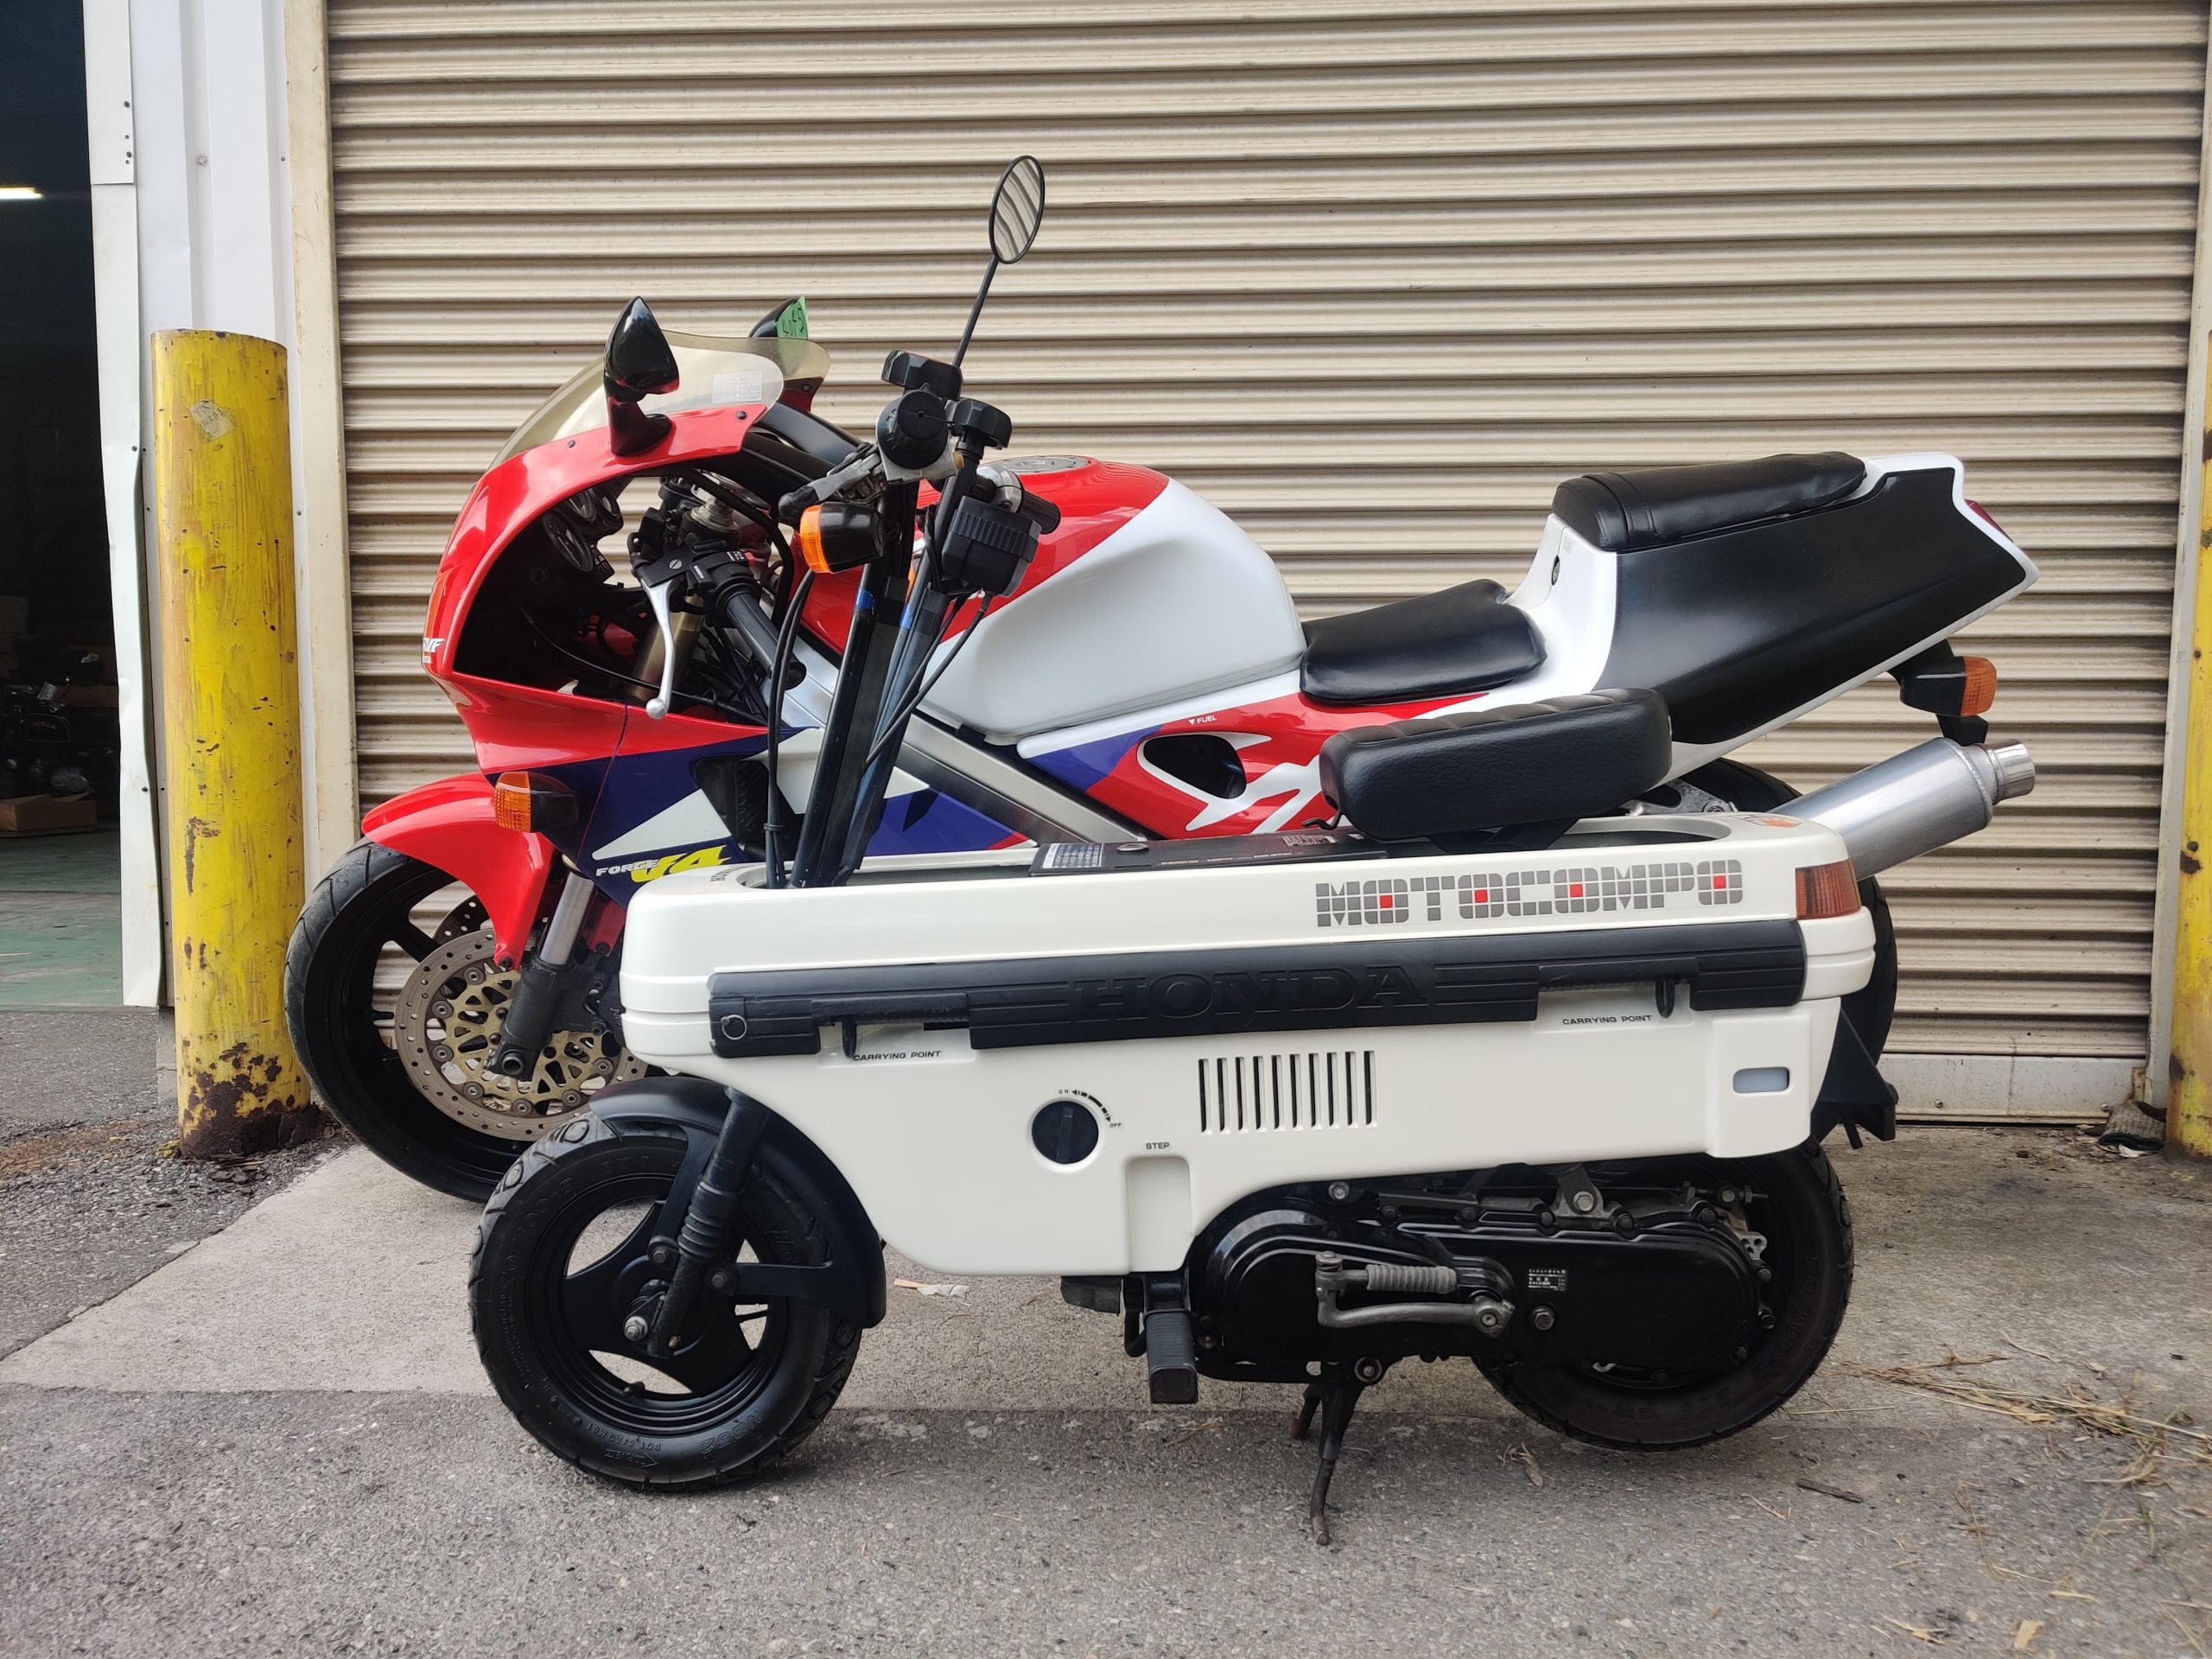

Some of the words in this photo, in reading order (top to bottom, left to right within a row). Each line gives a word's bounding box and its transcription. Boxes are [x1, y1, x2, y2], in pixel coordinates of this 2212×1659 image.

[1197, 715, 1217, 724] FUEL
[595, 859, 659, 877] FORCE
[631, 844, 732, 883] V4
[1315, 859, 1744, 927] MOTOCOMPO
[1073, 965, 1429, 1023] HONDA
[1561, 1016, 1618, 1026] CARRYING
[1620, 1014, 1653, 1023] POINT
[853, 1052, 907, 1062] CARRYING
[910, 1050, 942, 1058] POINT
[1145, 1141, 1170, 1150] STEP
